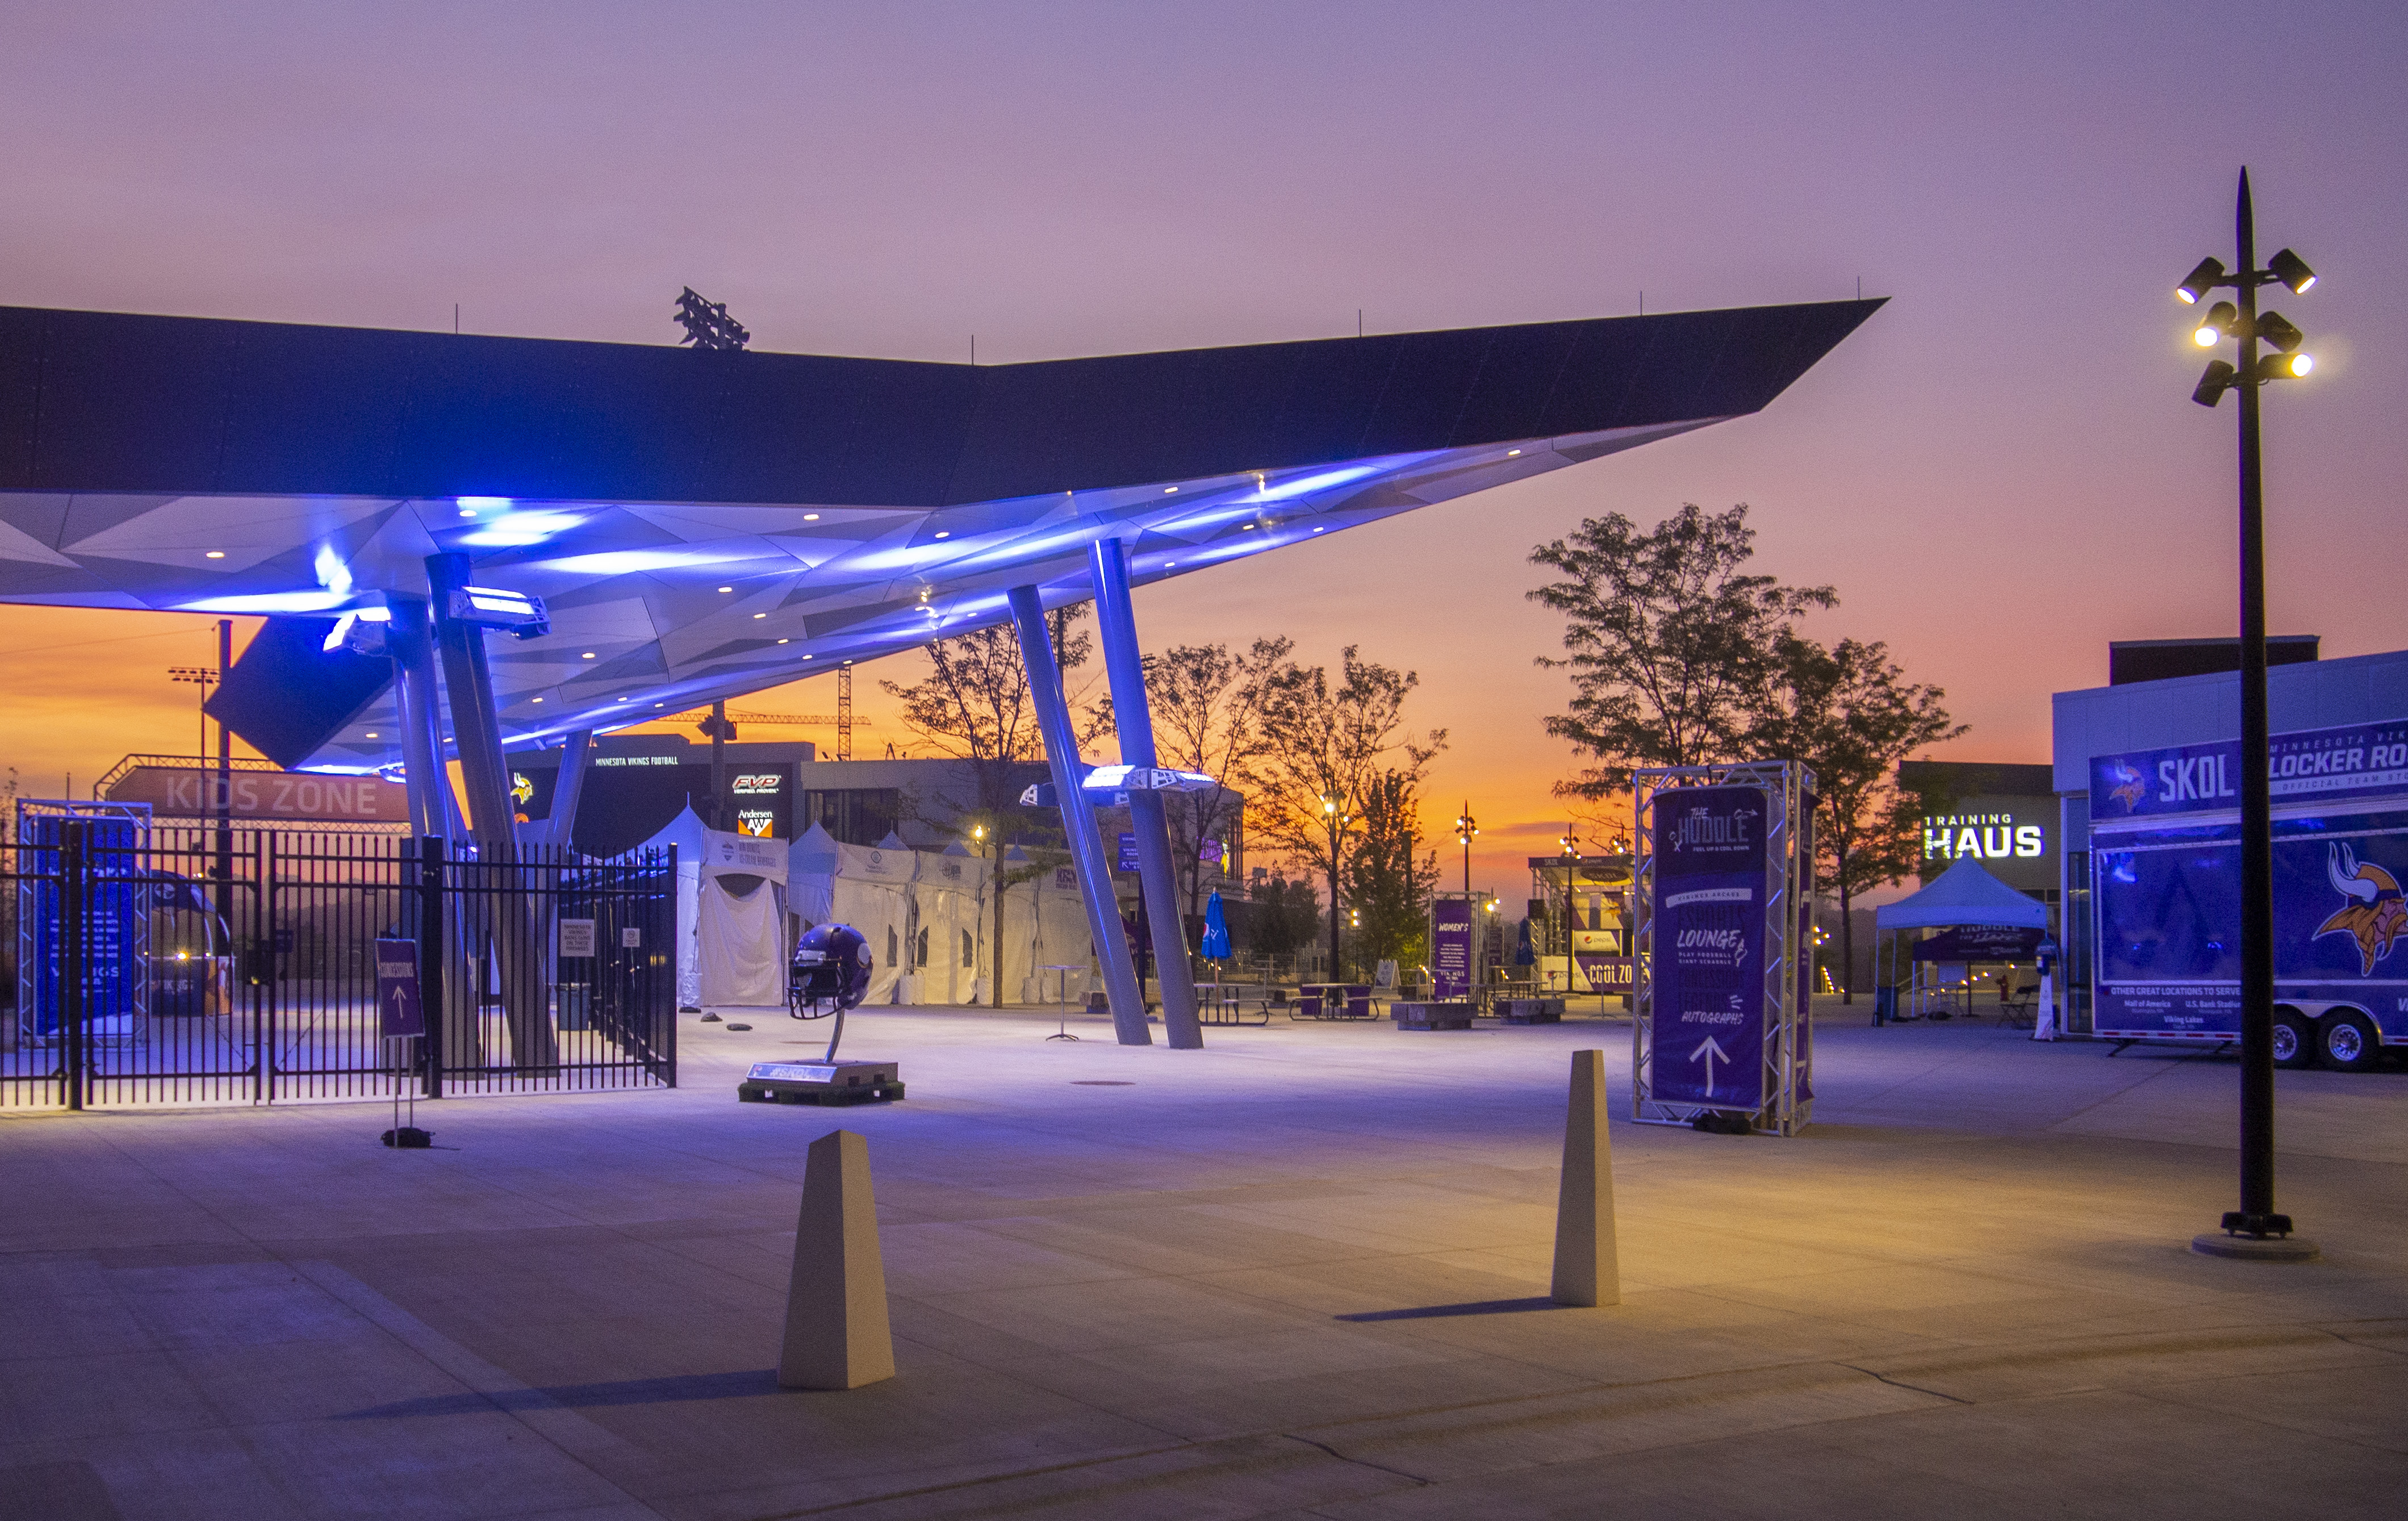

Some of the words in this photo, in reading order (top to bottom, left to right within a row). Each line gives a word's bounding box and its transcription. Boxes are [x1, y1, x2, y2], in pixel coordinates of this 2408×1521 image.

[2270, 735, 2363, 753] MINNESOTA
[595, 757, 626, 766] MINNESOTA
[628, 757, 650, 766] VIKINGS
[651, 756, 678, 765] FOOTBALL
[2269, 749, 2363, 778] LOCKER
[732, 775, 780, 789] FVP
[2159, 754, 2235, 803] SKOL
[2282, 779, 2339, 791] OFFICIAL
[166, 776, 258, 811] KIDS
[272, 779, 377, 814] ZONE
[738, 809, 773, 818] Andersen
[1691, 807, 1708, 820] THE
[1924, 813, 2012, 826] TRAINING
[1679, 816, 1749, 843] HUDDLE
[1923, 825, 2043, 860] HAUS
[1439, 922, 1469, 932] WOMEN'S
[1677, 929, 1741, 949] LOUNGE
[1590, 965, 1617, 984] COOL
[1682, 1011, 1744, 1025] AUTOGRAPHS
[2163, 1016, 2184, 1024] Viking
